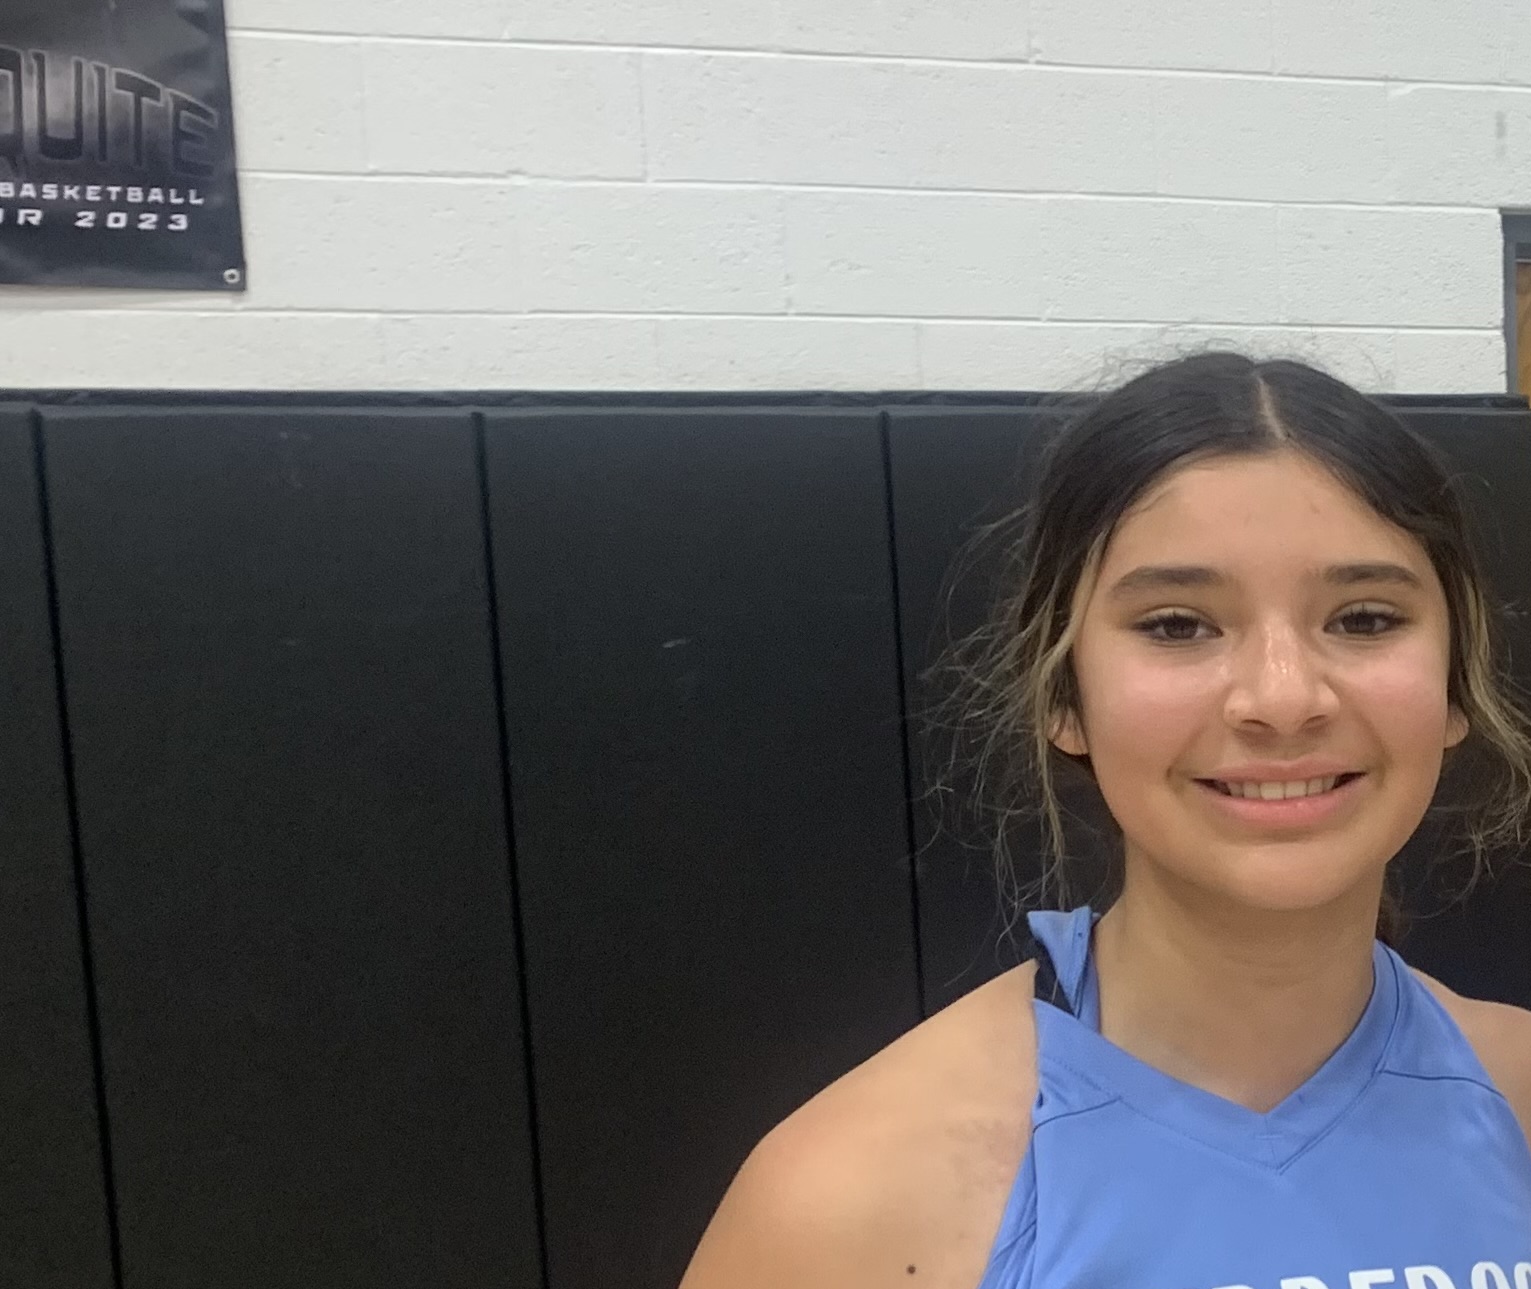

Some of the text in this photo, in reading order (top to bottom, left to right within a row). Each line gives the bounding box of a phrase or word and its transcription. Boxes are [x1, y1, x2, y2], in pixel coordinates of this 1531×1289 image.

[0, 182, 204, 204] BASKETBALL
[0, 208, 189, 230] R 2023
